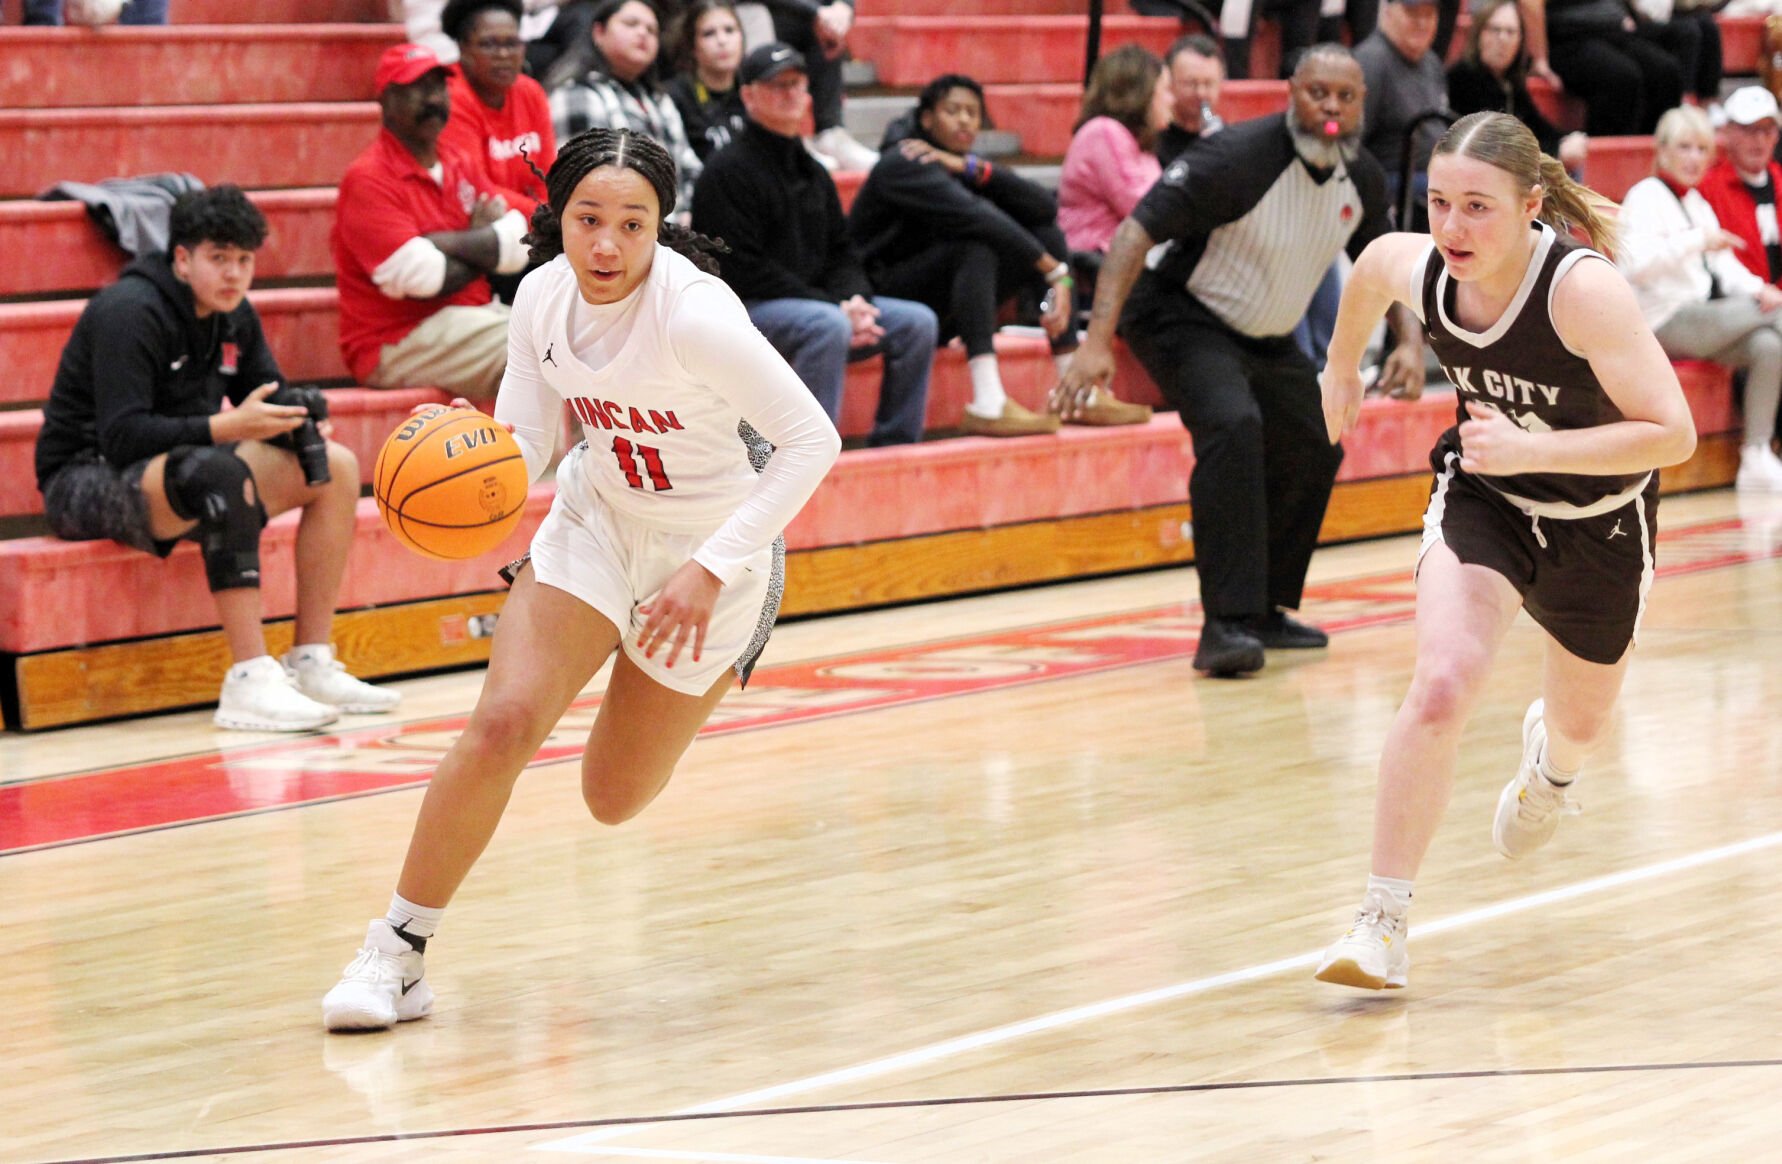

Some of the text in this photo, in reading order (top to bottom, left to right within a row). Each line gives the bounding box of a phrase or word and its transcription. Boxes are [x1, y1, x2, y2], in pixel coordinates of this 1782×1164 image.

[1482, 369, 1561, 406] CITY
[565, 397, 685, 434] UNCAN
[611, 435, 674, 491] 11
